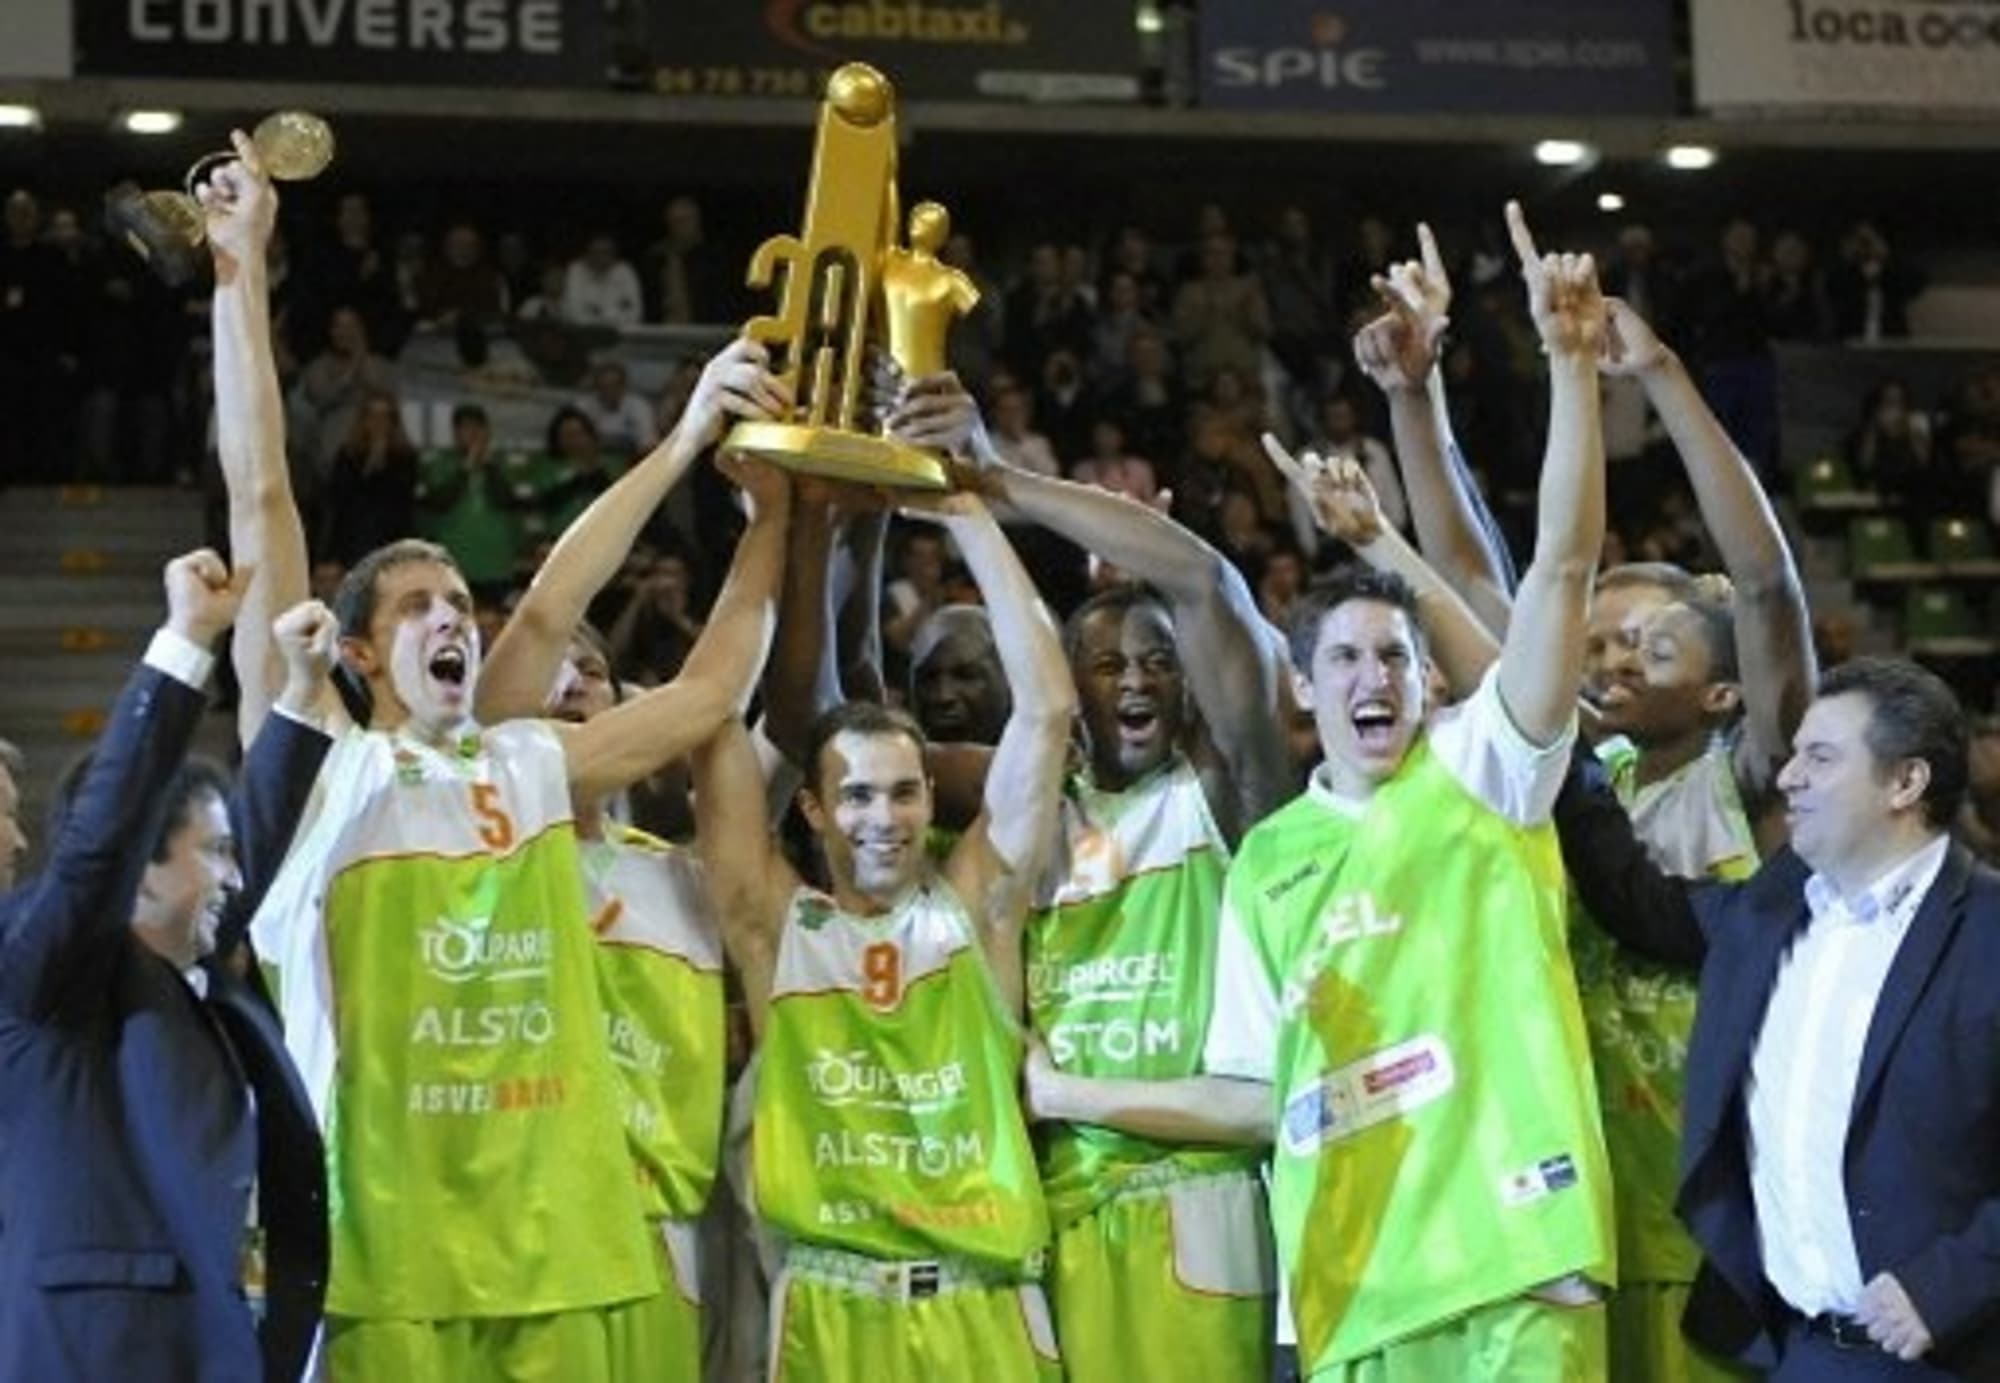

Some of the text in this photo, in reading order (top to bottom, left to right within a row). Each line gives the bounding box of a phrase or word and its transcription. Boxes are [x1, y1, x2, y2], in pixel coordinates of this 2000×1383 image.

[129, 0, 563, 53] CONVERSE
[1212, 45, 1387, 89] SPIE
[470, 783, 513, 850] 5
[863, 941, 902, 1013] 9
[815, 1129, 985, 1177] ALSTOM
